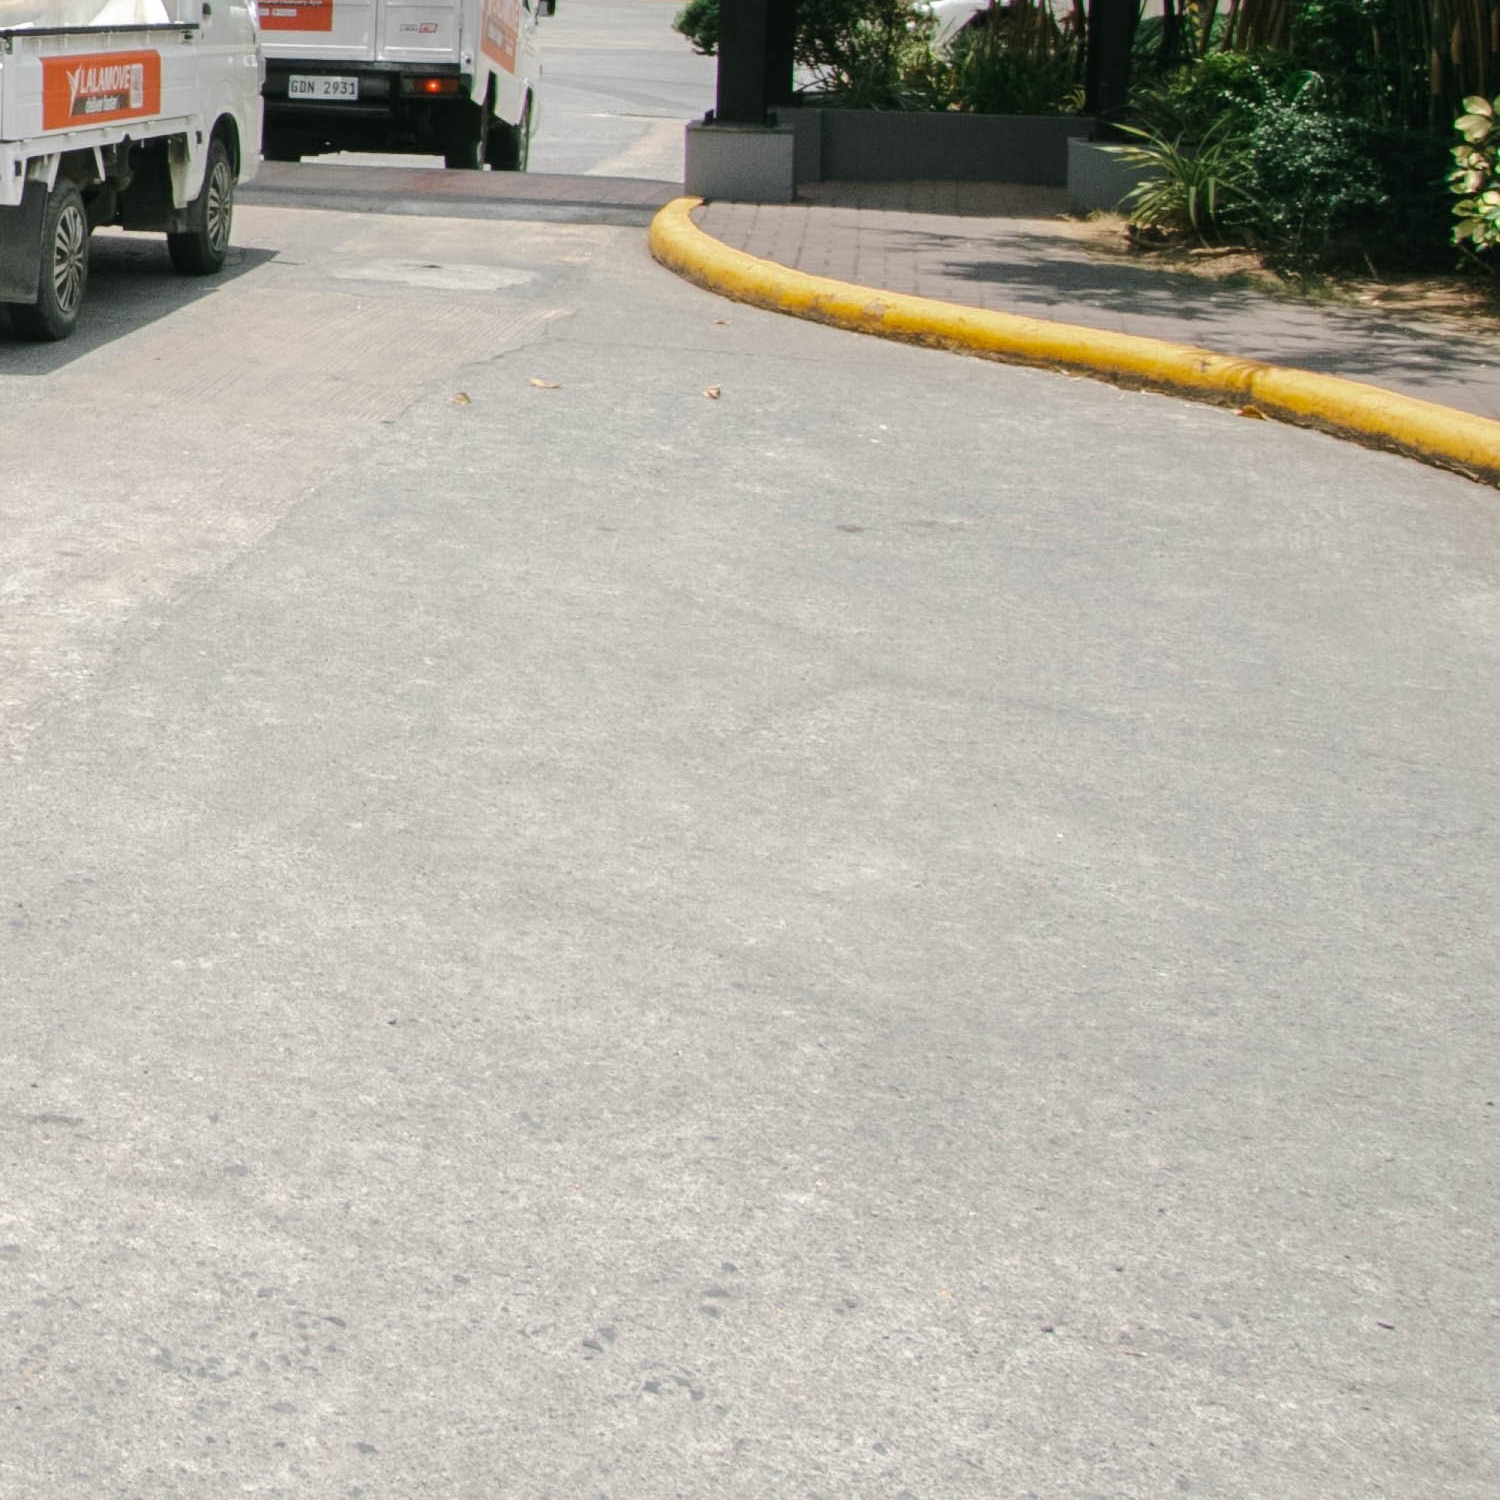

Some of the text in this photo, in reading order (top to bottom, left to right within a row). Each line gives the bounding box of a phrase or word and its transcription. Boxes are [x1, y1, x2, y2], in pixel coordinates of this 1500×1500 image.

[80, 64, 131, 94] LALAMOVE
[290, 80, 356, 95] GDN 2931
